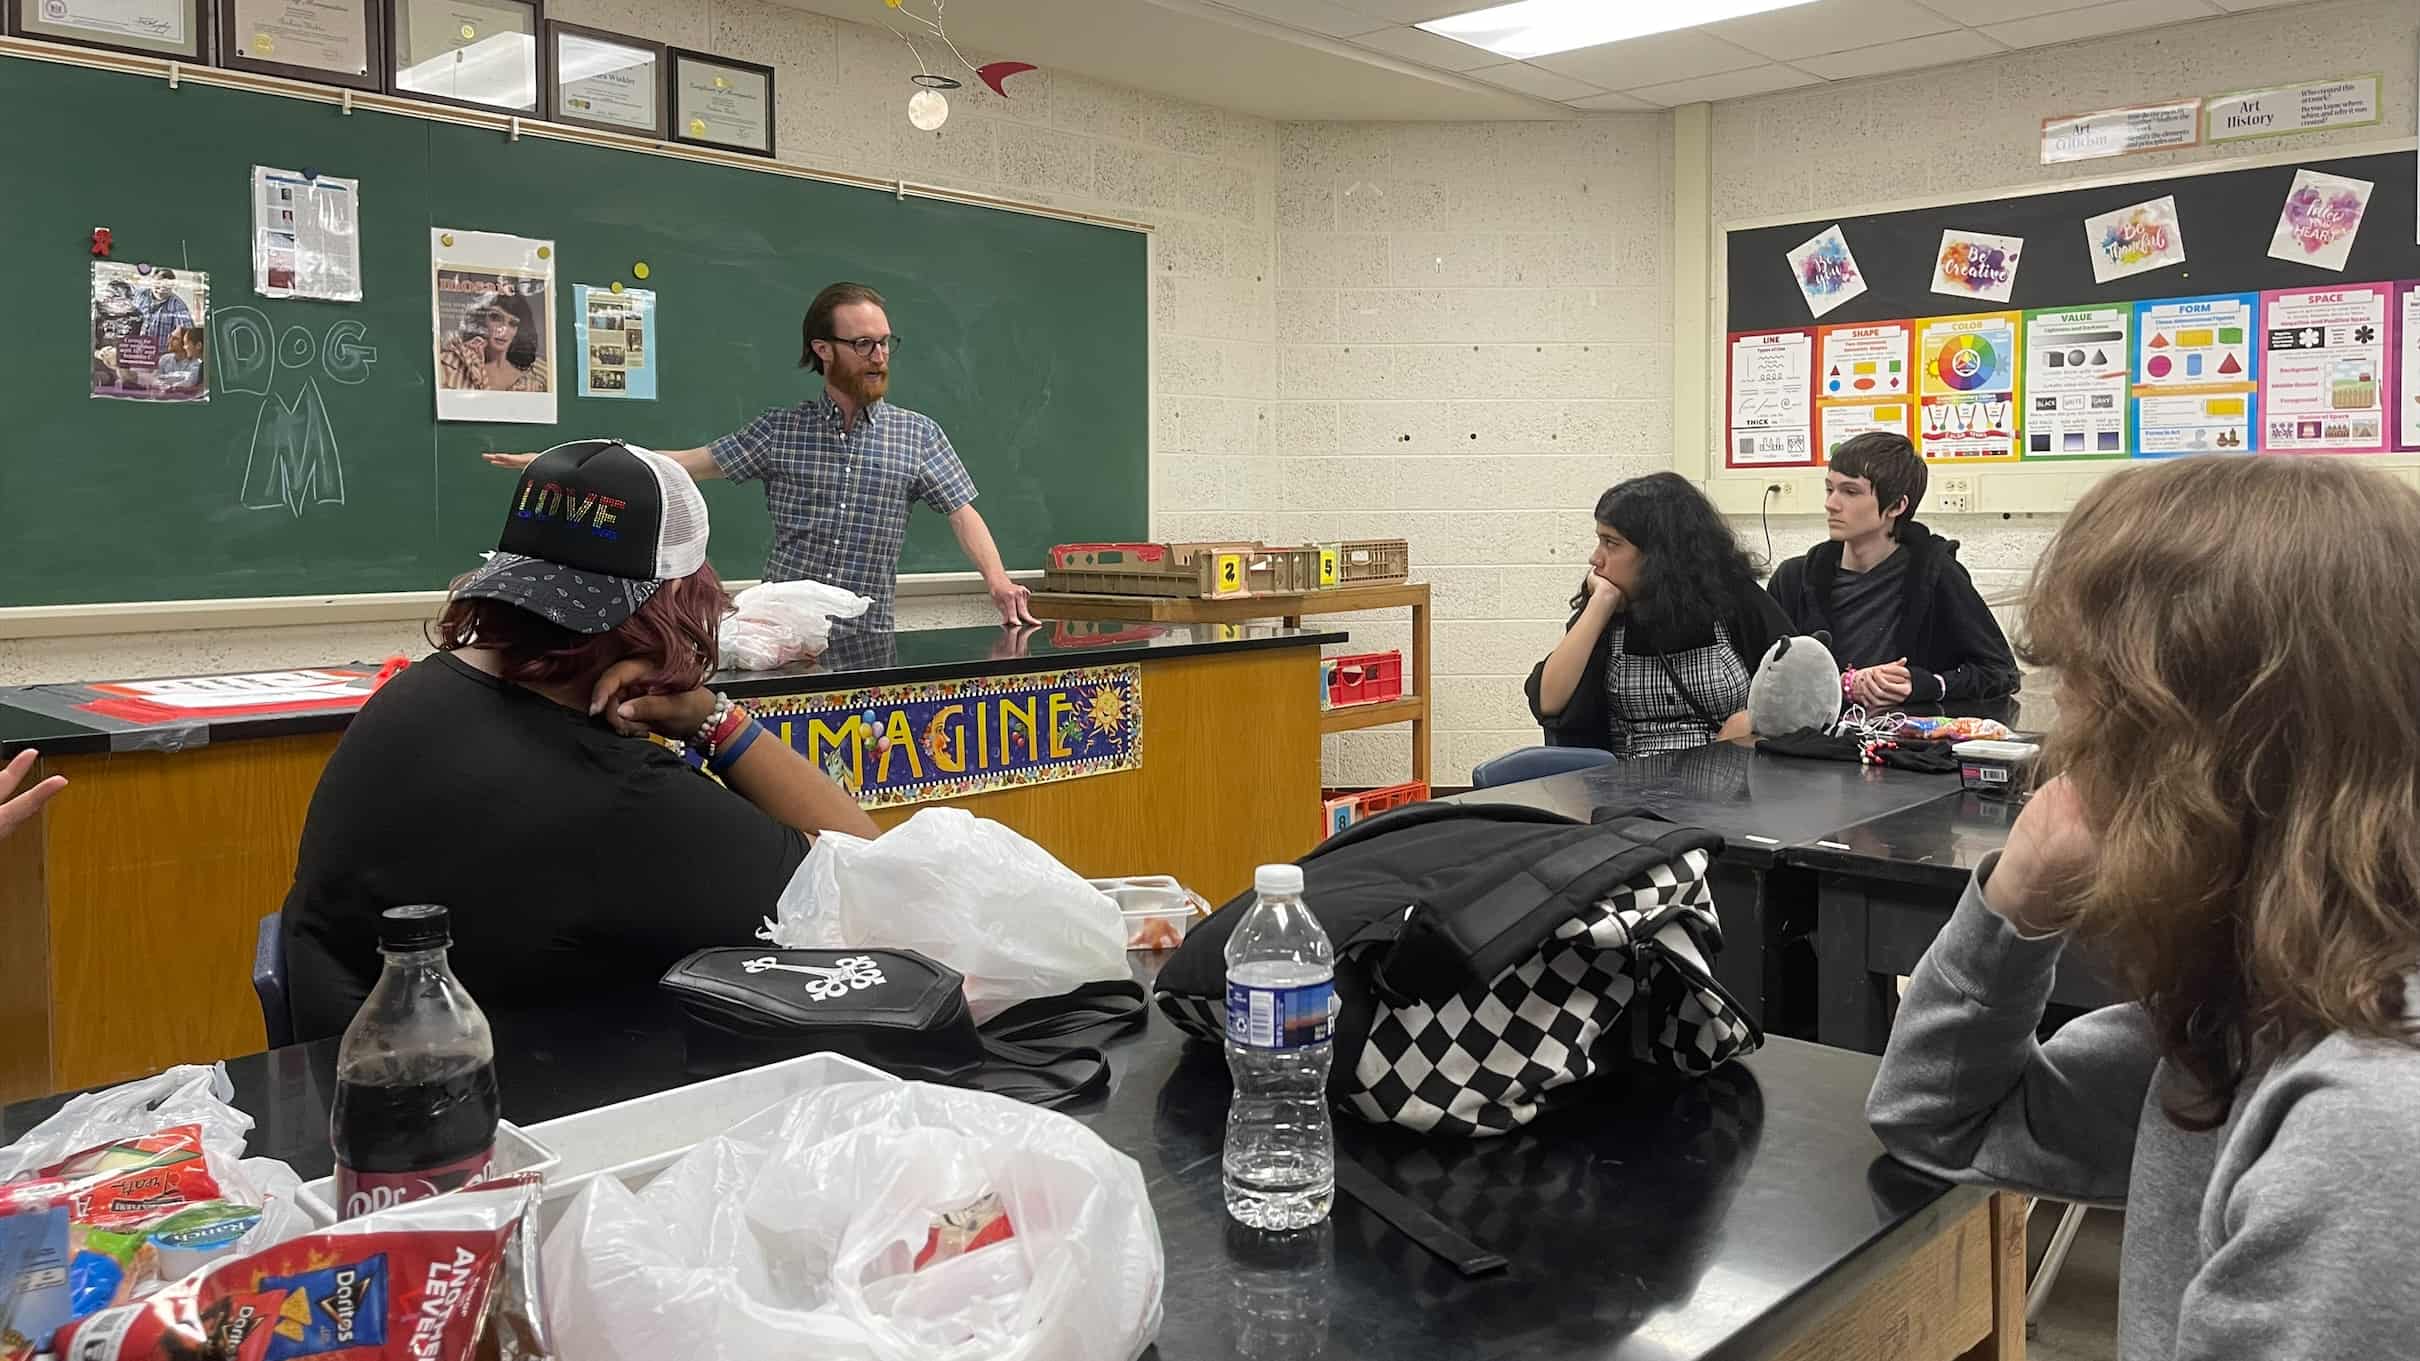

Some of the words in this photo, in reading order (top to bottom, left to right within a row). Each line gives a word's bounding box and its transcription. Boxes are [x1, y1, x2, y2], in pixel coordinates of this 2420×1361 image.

[2240, 100, 2261, 114] Art
[2226, 112, 2275, 129] History
[2072, 123, 2091, 137] Art
[2123, 222, 2145, 241] Be
[1967, 245, 1987, 264] Be
[1945, 258, 2008, 283] Creative
[2308, 294, 2344, 304] SPACE
[2061, 313, 2092, 323] VALUE
[2179, 304, 2211, 314] FORM
[1852, 329, 1880, 338] SHAPE
[1952, 321, 1983, 331] COLOR
[1763, 336, 1780, 344] LINE
[212, 305, 378, 396] DOG
[517, 480, 627, 541] LOVE
[1224, 562, 1236, 583] 2
[1324, 558, 1333, 577] 5
[1338, 815, 1347, 831] 8
[172, 1220, 247, 1243] Ranch
[335, 1270, 356, 1343] Doritos
[420, 1246, 476, 1361] ANOTHE
